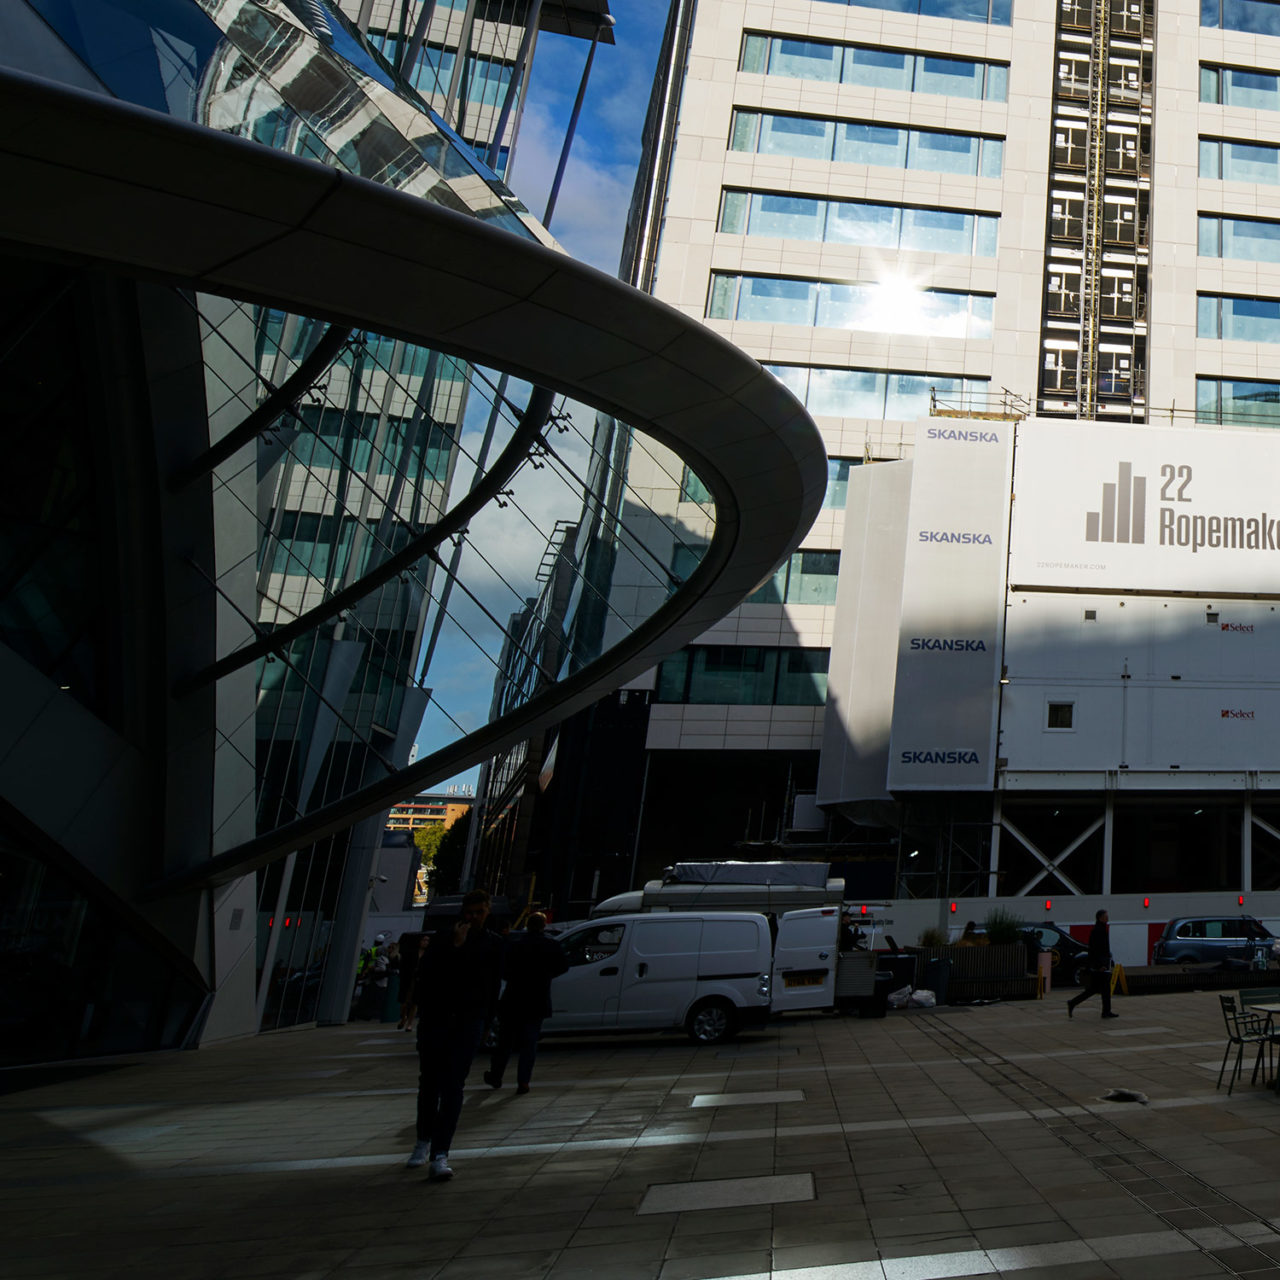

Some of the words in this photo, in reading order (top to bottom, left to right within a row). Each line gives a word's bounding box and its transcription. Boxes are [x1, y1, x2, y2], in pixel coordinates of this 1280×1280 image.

[927, 427, 999, 444] SKANSKA
[1160, 464, 1193, 503] 22
[918, 530, 993, 545] SKANSKA
[1229, 623, 1254, 632] Select
[910, 638, 986, 652] SKANSKA
[1229, 709, 1255, 719] Select
[901, 751, 980, 765] SKANSKA
